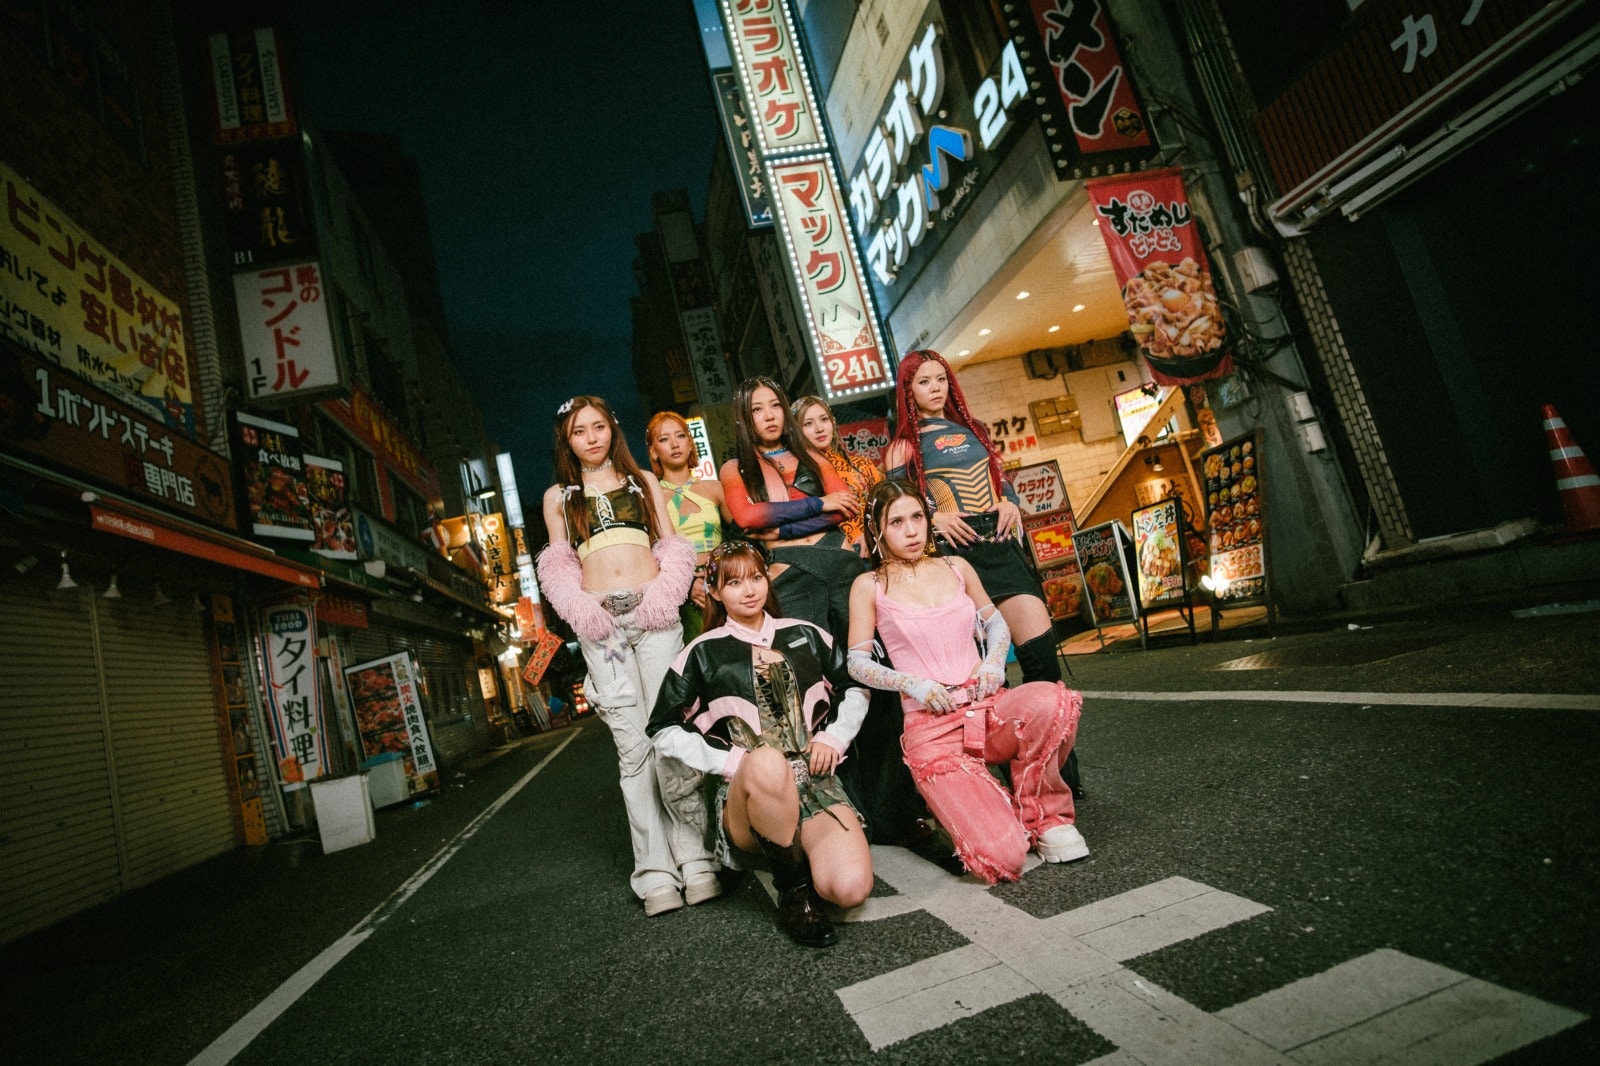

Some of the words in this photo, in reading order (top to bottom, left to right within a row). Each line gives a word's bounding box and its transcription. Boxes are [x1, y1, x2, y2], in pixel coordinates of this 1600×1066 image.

[1043, 0, 1123, 139] メン
[973, 39, 1030, 151] 24
[849, 22, 942, 237] カラオケ
[781, 169, 843, 293] マック
[866, 173, 928, 287] マック
[1098, 198, 1192, 236] すためし
[233, 250, 254, 265] B1
[80, 290, 188, 390] 安いお店
[259, 269, 310, 392] コンドル
[827, 353, 882, 388] 24h
[842, 433, 888, 453] すためし
[984, 416, 1028, 437] オケ
[143, 462, 197, 507] 専門店
[1017, 475, 1056, 495] カラオケ
[1025, 489, 1055, 504] マック
[1035, 502, 1053, 513] 24H
[274, 620, 303, 632] FOOD
[276, 637, 318, 766] タイ料理
